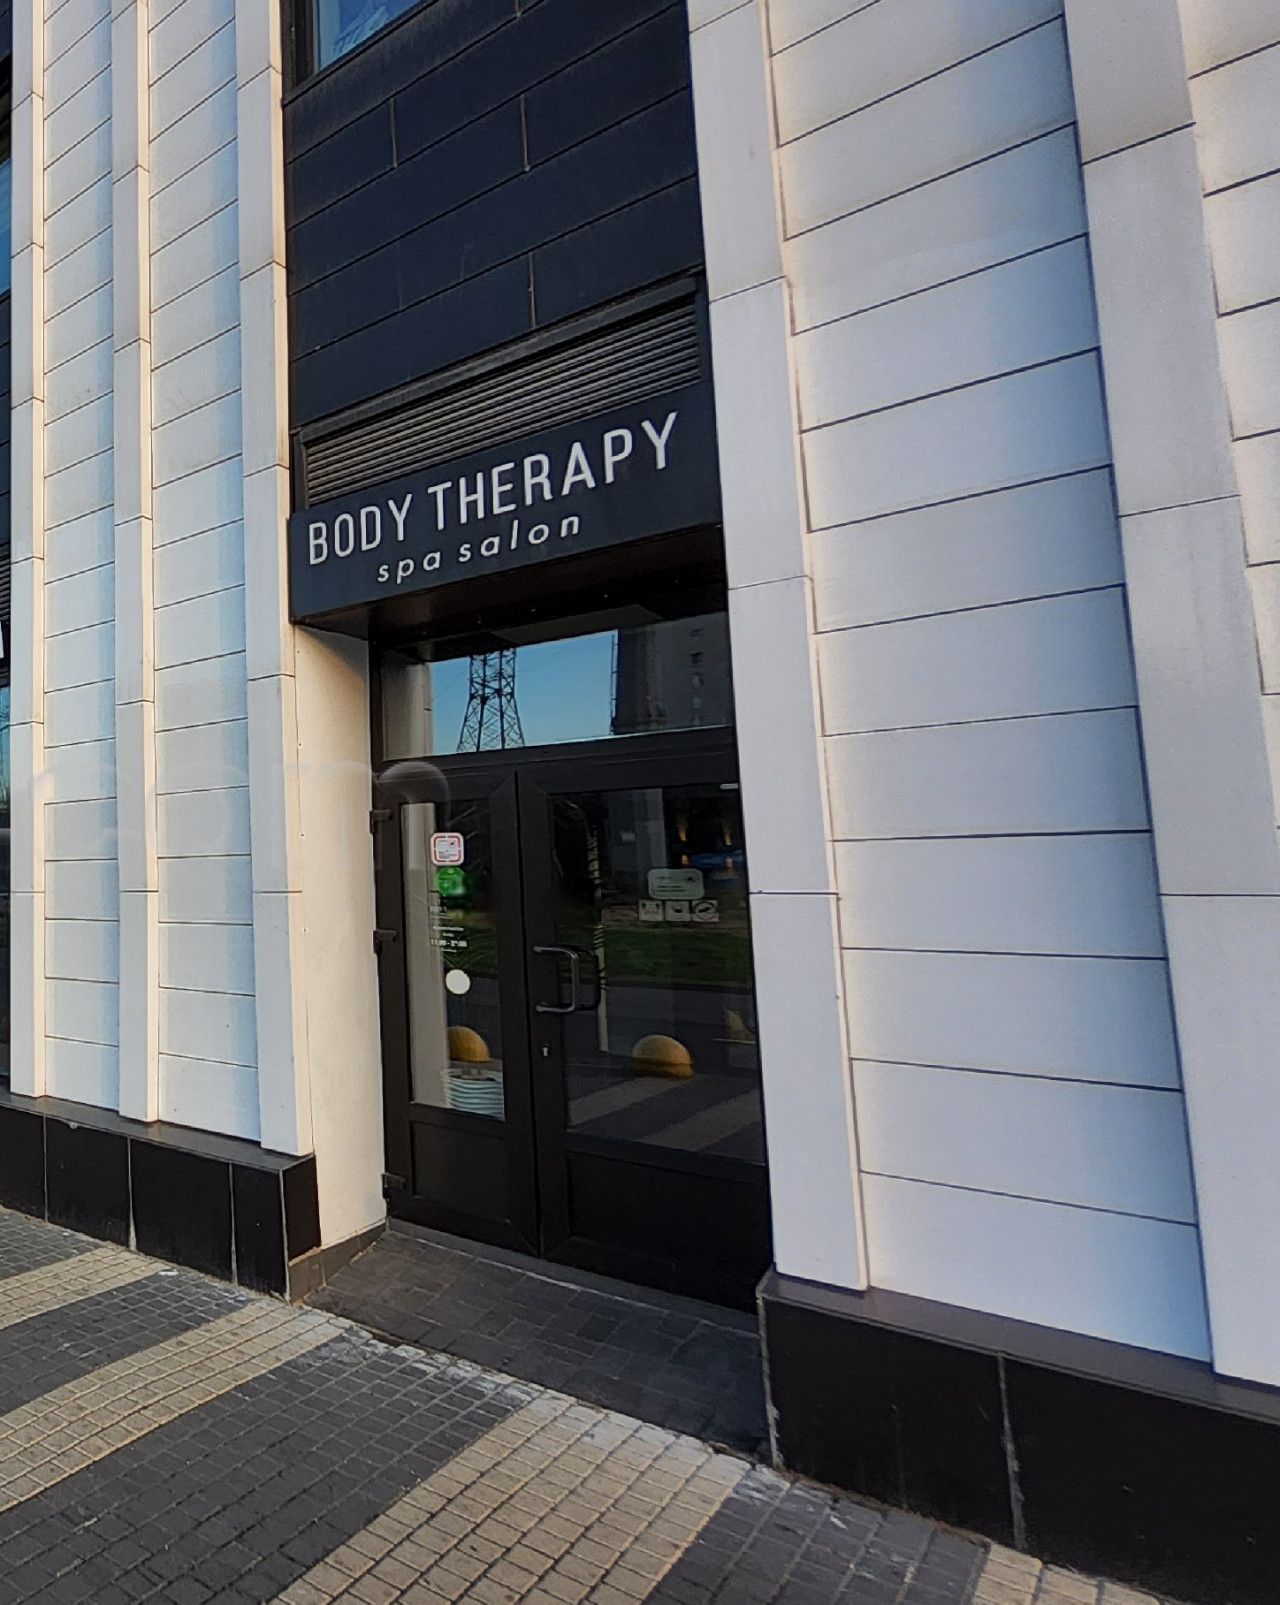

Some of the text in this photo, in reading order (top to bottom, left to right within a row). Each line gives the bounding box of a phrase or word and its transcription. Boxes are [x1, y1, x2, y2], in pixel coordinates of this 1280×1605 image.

[308, 411, 679, 566] BODY THERAPY
[377, 515, 580, 585] spa salon
